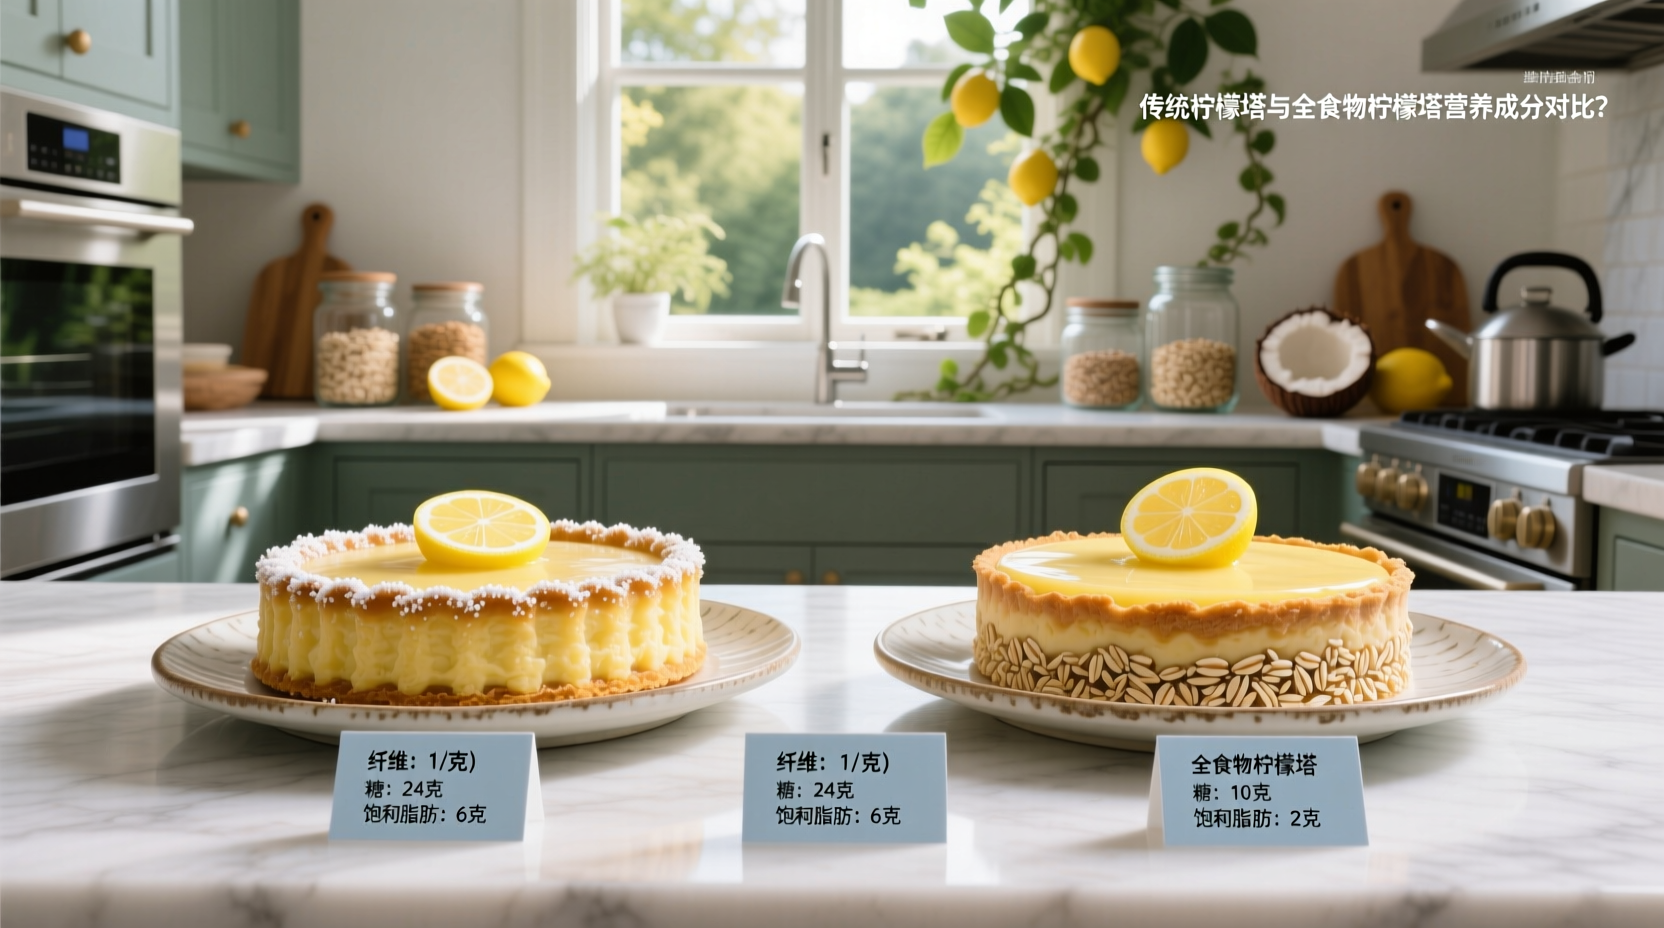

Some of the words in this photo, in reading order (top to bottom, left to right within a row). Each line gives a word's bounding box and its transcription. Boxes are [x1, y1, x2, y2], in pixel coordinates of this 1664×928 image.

[1191, 752, 1318, 777] 全食物柠檬塔
